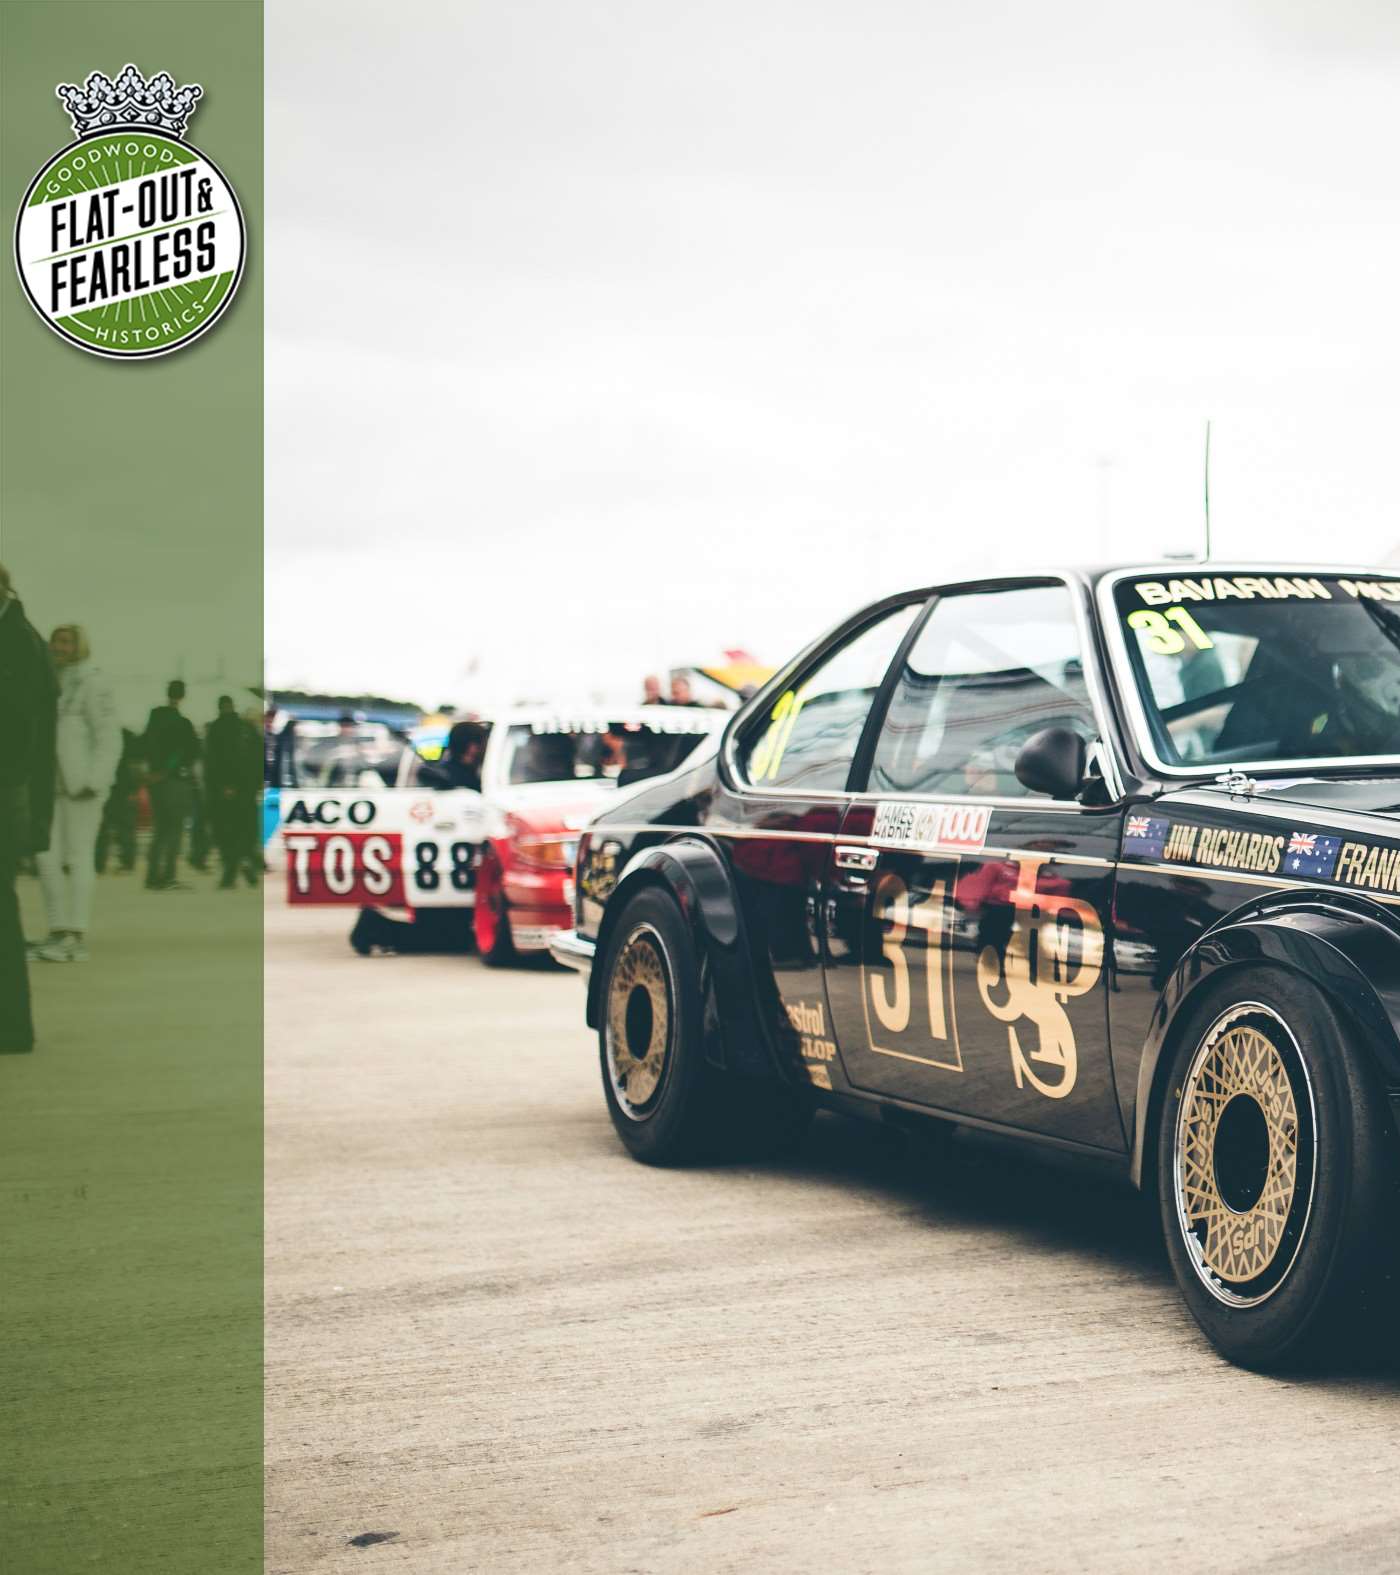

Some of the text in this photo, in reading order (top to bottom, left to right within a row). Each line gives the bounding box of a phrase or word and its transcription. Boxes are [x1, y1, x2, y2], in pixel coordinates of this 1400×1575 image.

[1134, 577, 1332, 606] BAVARIAN
[1127, 606, 1214, 656] 31
[284, 799, 377, 826] ACO
[286, 834, 394, 896] TOS
[414, 840, 477, 892] 88
[1163, 824, 1286, 874] JIM RICHARDS
[869, 872, 948, 1042] 31
[1255, 1069, 1283, 1120] JPS
[1231, 1217, 1265, 1256] JPS
